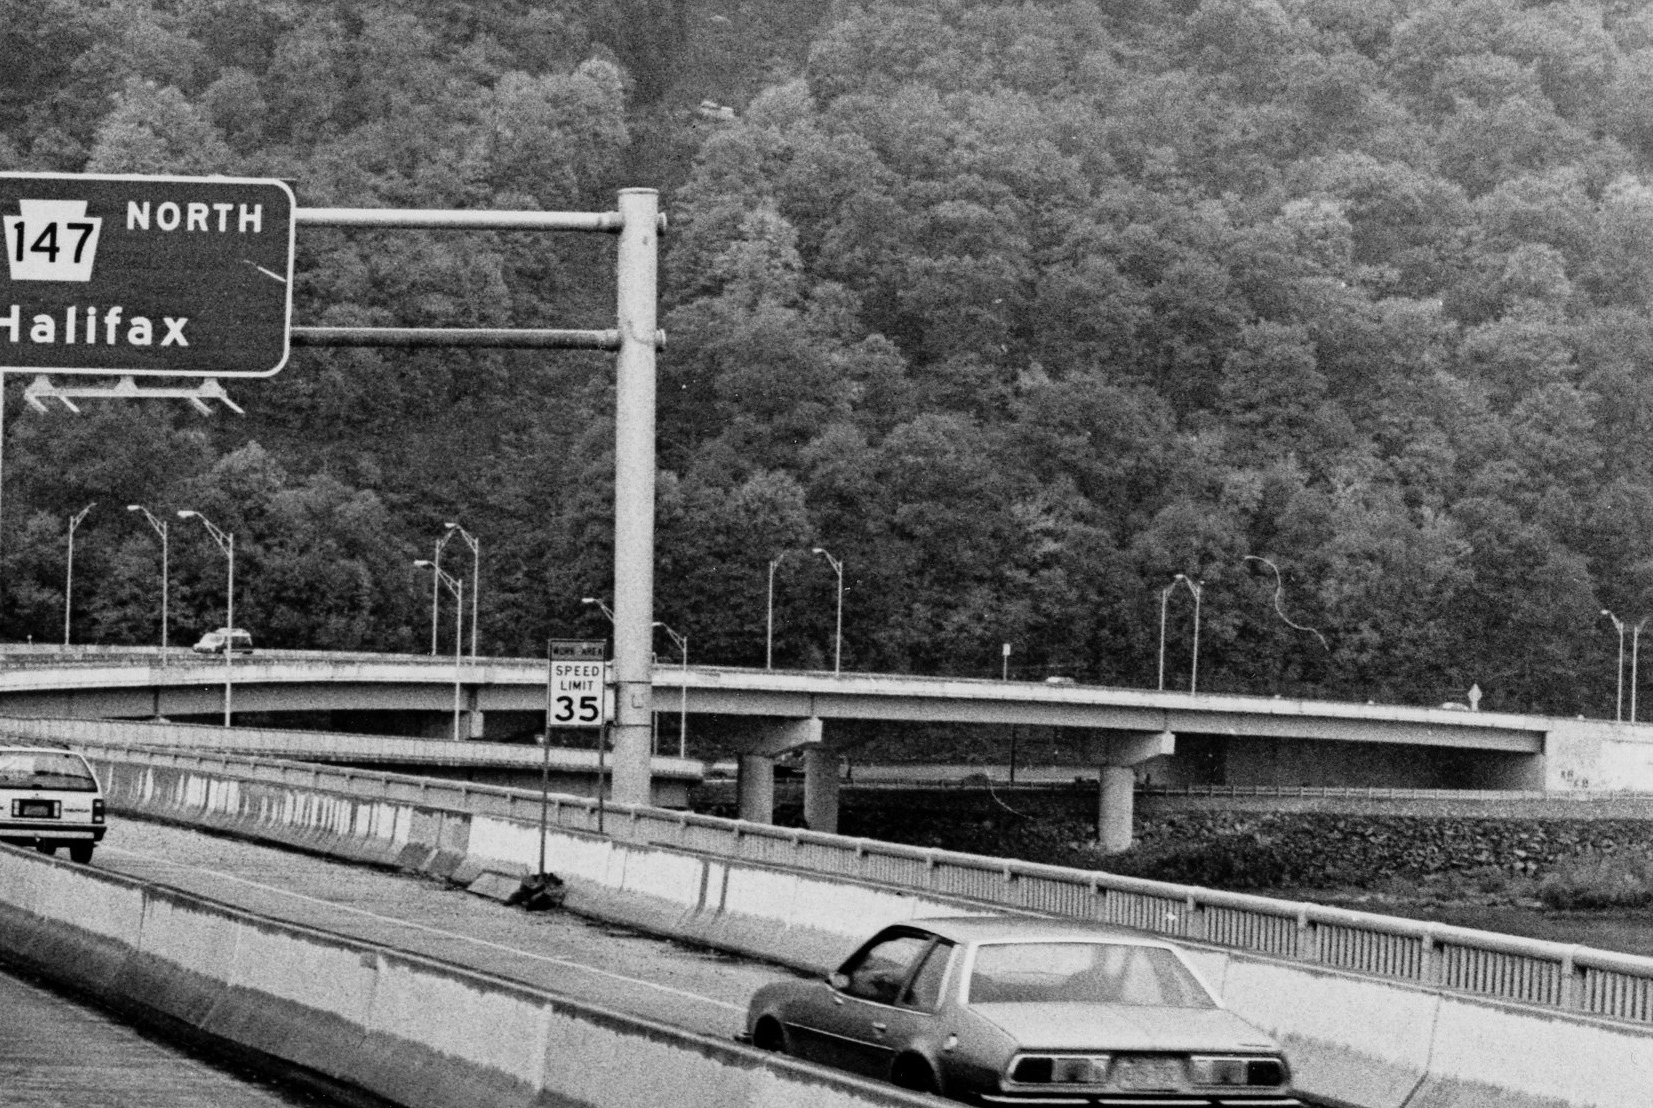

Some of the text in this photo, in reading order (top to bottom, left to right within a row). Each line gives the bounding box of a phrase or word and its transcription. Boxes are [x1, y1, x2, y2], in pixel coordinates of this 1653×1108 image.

[127, 201, 262, 233] NORTH
[13, 221, 94, 263] 147
[556, 665, 599, 676] SPEED
[560, 680, 594, 691] LIMIT
[555, 696, 598, 721] 35
